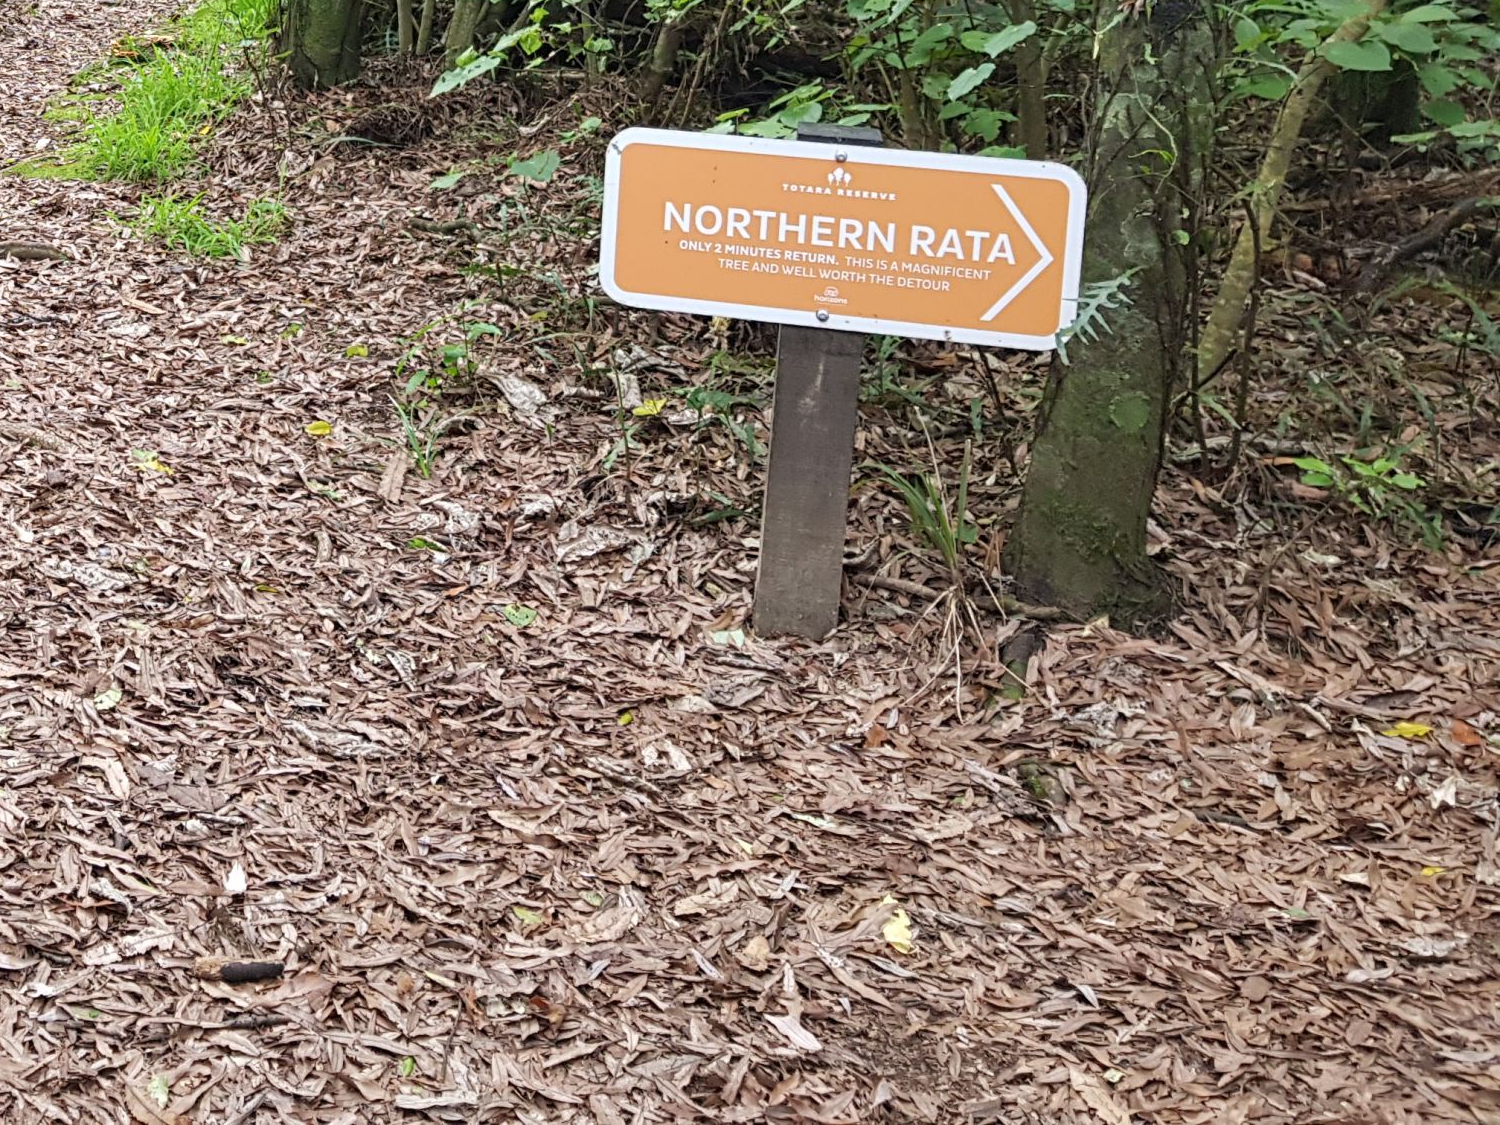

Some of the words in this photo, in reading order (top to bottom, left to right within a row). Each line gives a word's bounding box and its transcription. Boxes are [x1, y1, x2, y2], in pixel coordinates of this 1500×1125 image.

[782, 183, 832, 195] TOTARA
[837, 188, 897, 201] RESERVE
[663, 201, 896, 253] NORTHERN
[909, 224, 1016, 265] RATA
[679, 239, 713, 252] ONLY
[714, 243, 723, 254] 2
[724, 244, 782, 259] MINUTES
[784, 250, 840, 265] RETURN.
[845, 256, 874, 269] THIS
[876, 259, 888, 270] IS
[889, 261, 899, 271] A
[901, 262, 992, 280] MAGNIFICENT
[718, 258, 750, 271] TREE
[751, 261, 779, 274] AND
[782, 264, 817, 278] WELL
[819, 268, 866, 283] WORTH
[869, 273, 895, 286] THE
[897, 276, 951, 292] DETOUR
